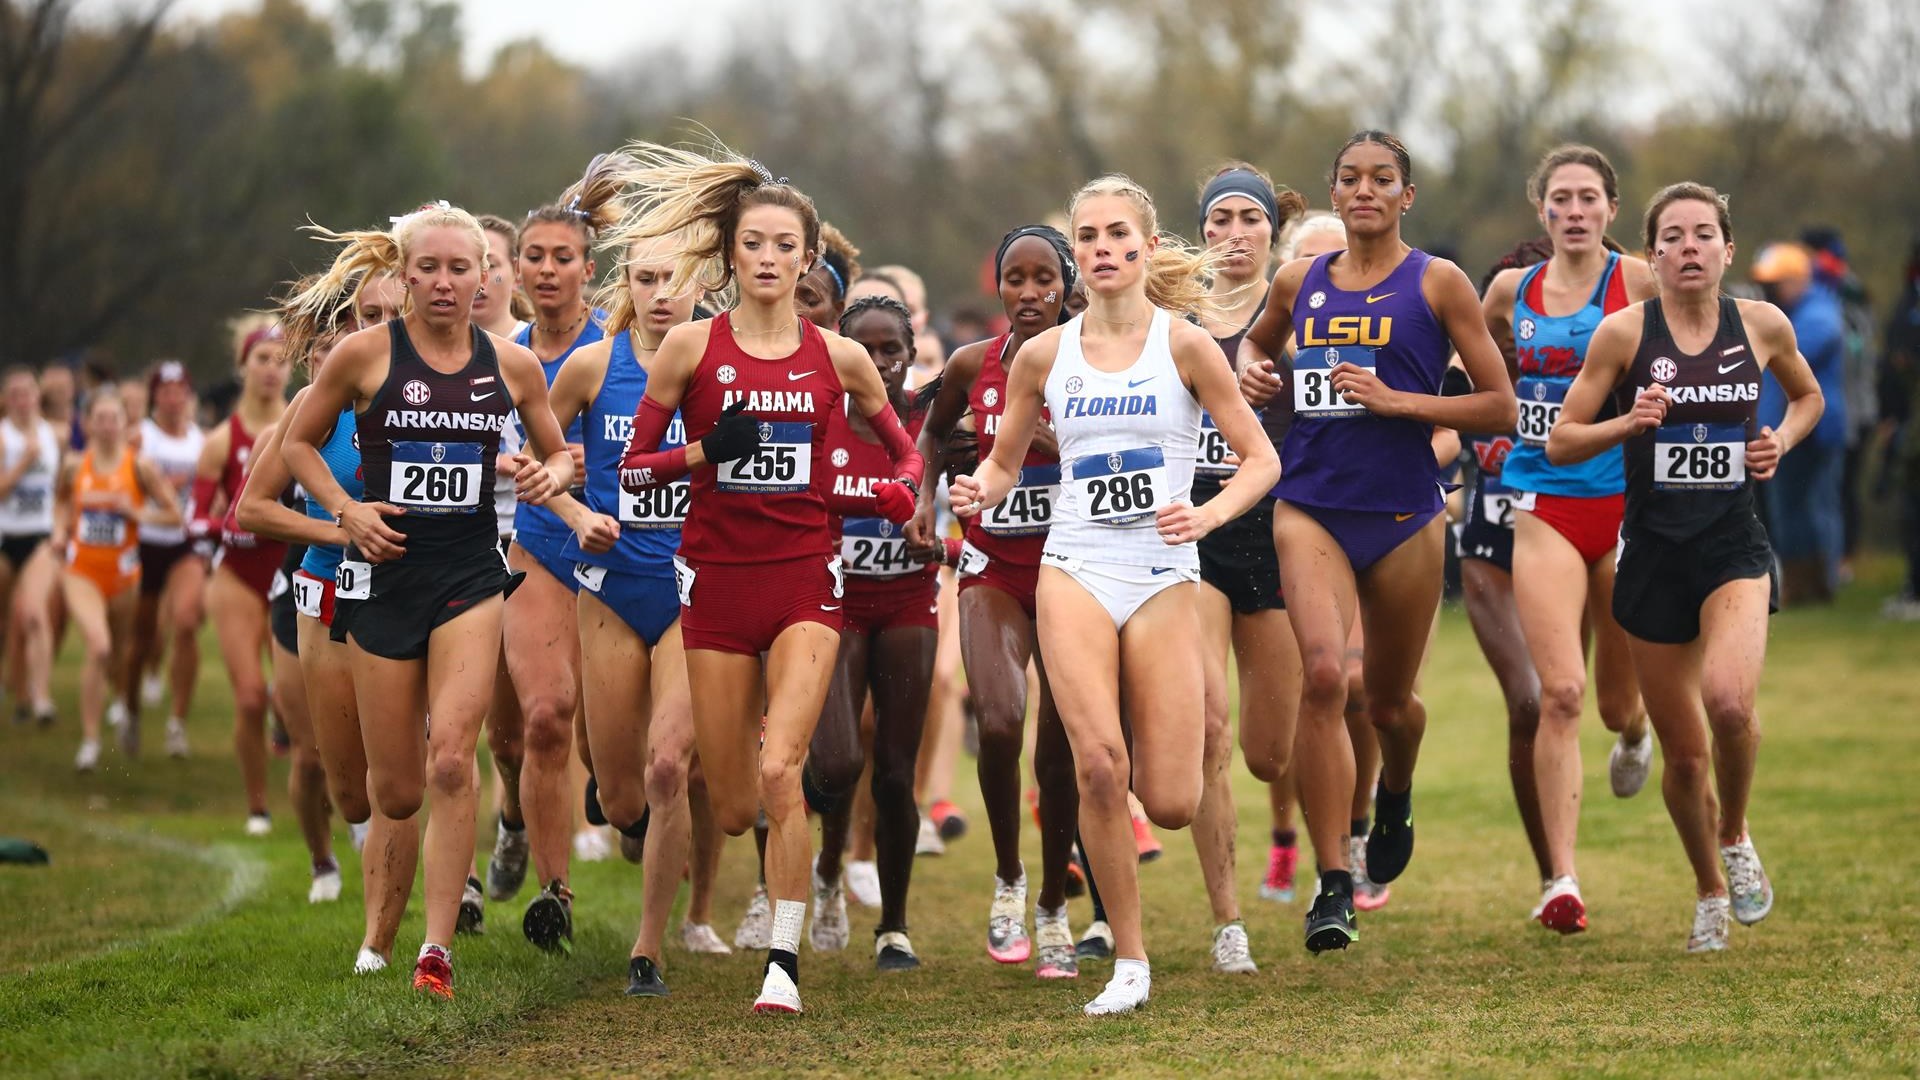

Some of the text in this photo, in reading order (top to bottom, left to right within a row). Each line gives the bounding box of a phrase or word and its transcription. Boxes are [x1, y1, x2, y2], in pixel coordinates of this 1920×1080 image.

[1304, 316, 1392, 347] LSU
[1519, 318, 1535, 341] SEC
[717, 366, 736, 384] SEC
[1652, 358, 1677, 381] SEC
[404, 382, 430, 404] SEC
[722, 390, 815, 413] ALABAMA
[1064, 395, 1157, 419] FLORIDA
[384, 410, 507, 432] ARKANSAS
[731, 446, 796, 481] 255
[1668, 446, 1731, 480] 268
[403, 466, 468, 502] 260
[1087, 473, 1154, 517] 286
[632, 486, 691, 519] 302
[992, 489, 1051, 524] 245
[853, 539, 912, 571] 244
